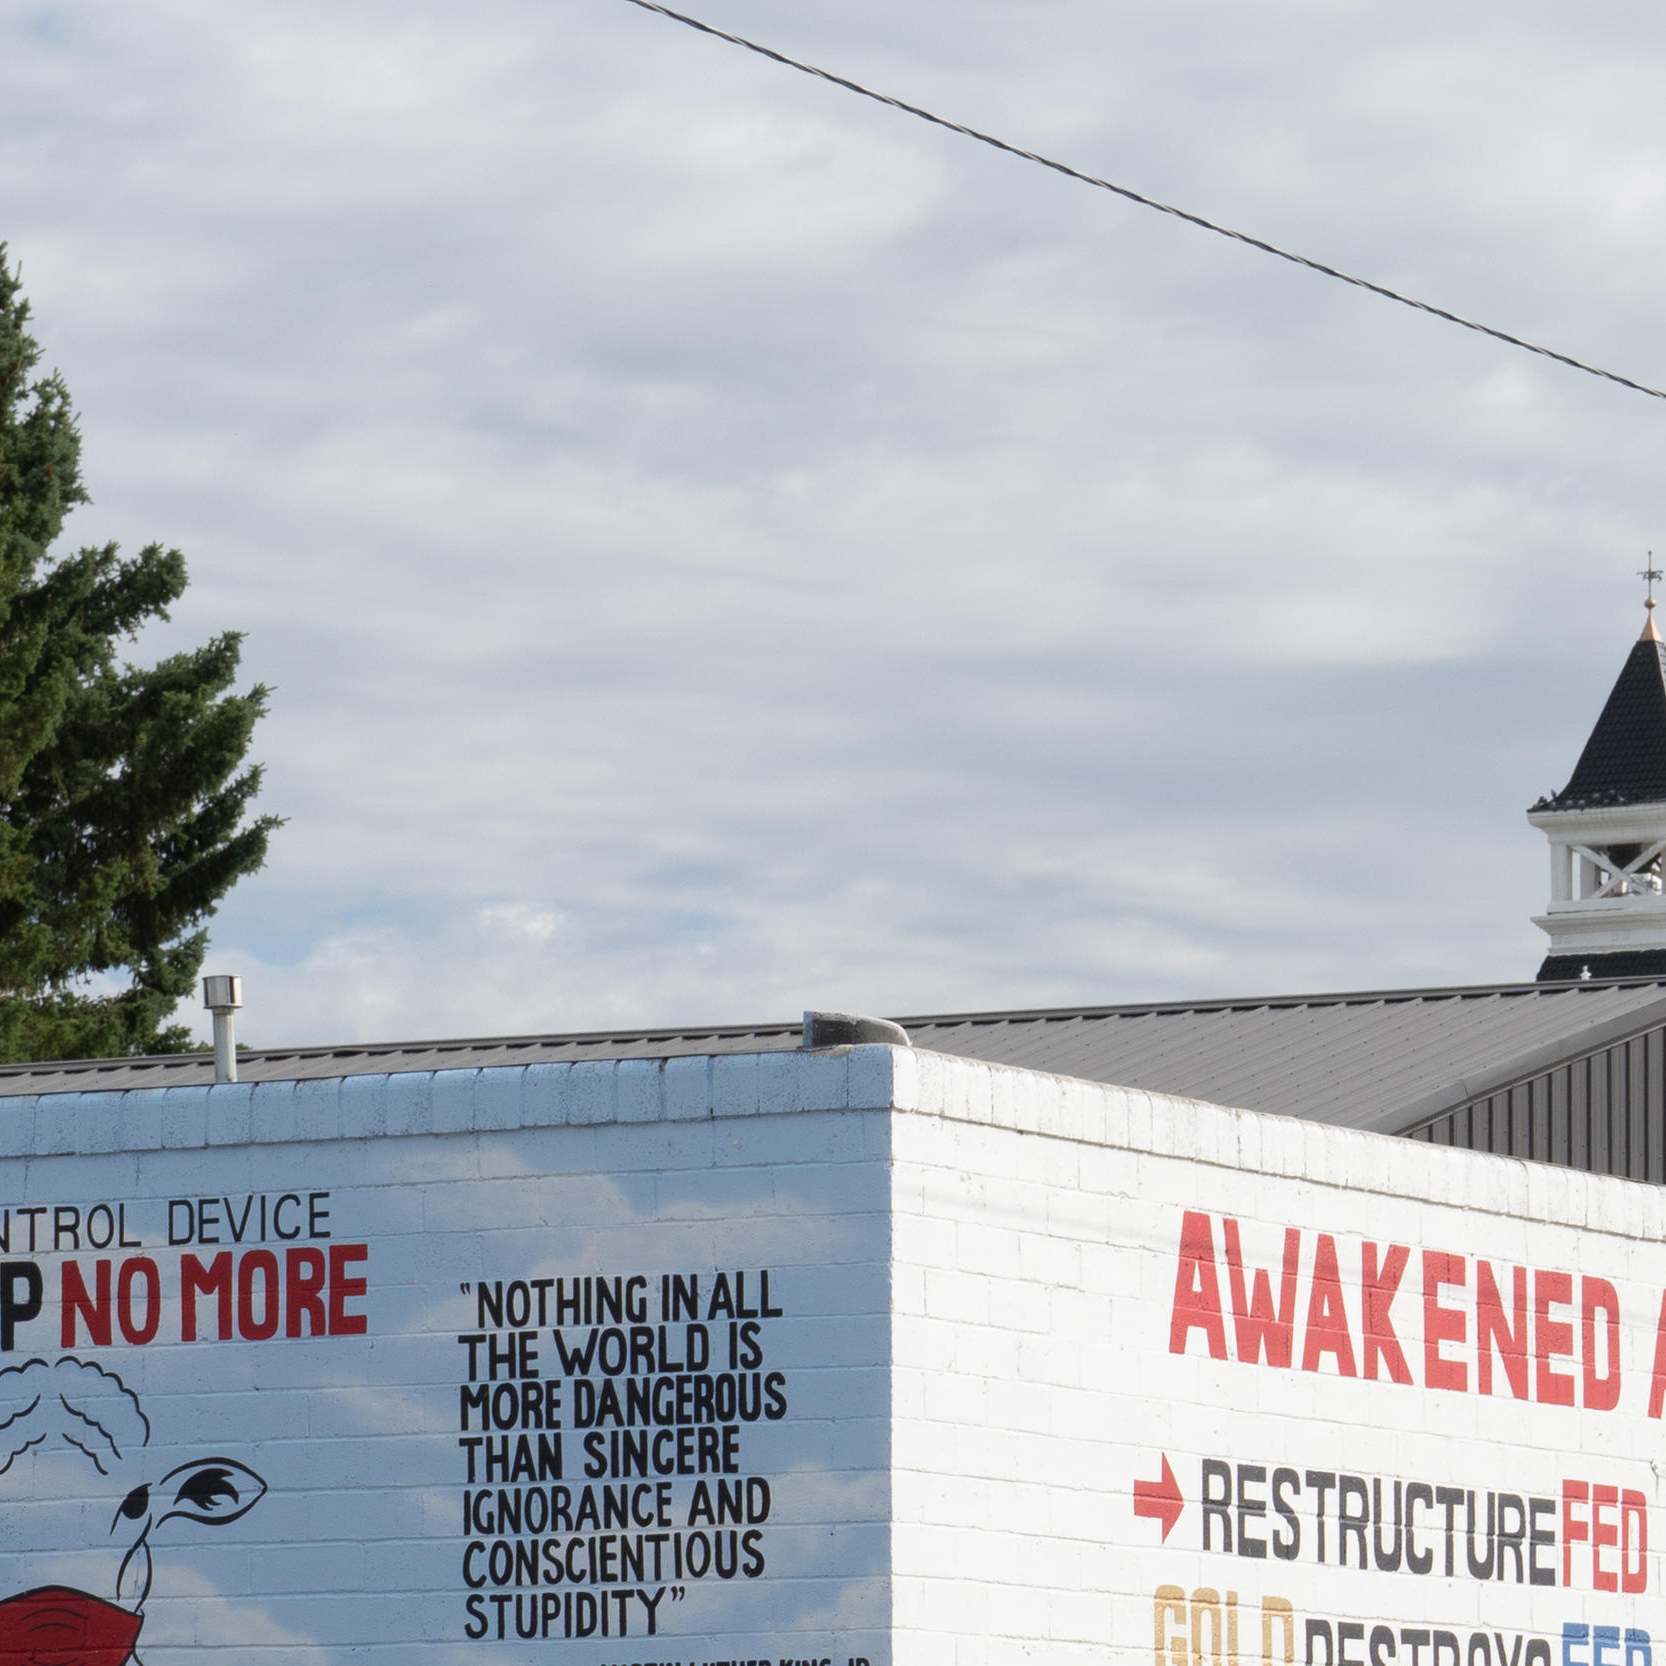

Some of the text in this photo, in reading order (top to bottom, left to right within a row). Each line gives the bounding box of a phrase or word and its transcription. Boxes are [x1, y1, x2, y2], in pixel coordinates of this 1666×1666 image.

[168, 1191, 331, 1246] DEVICE
[60, 1256, 161, 1349] NO
[180, 1243, 369, 1343] MORE
[662, 1273, 709, 1321] IN
[707, 1269, 783, 1321] ALL
[1169, 1210, 1621, 1412] AWAKENED
[457, 1321, 763, 1382] THE WORLD IS
[460, 1371, 788, 1432] MORE DANGEROUS
[458, 1424, 740, 1484] THAN SINCERE
[463, 1476, 771, 1536] IGNORANCE AND
[1200, 1457, 1649, 1594] RESTRUCTURE FED
[462, 1529, 765, 1589] CONSCIENTIOUS
